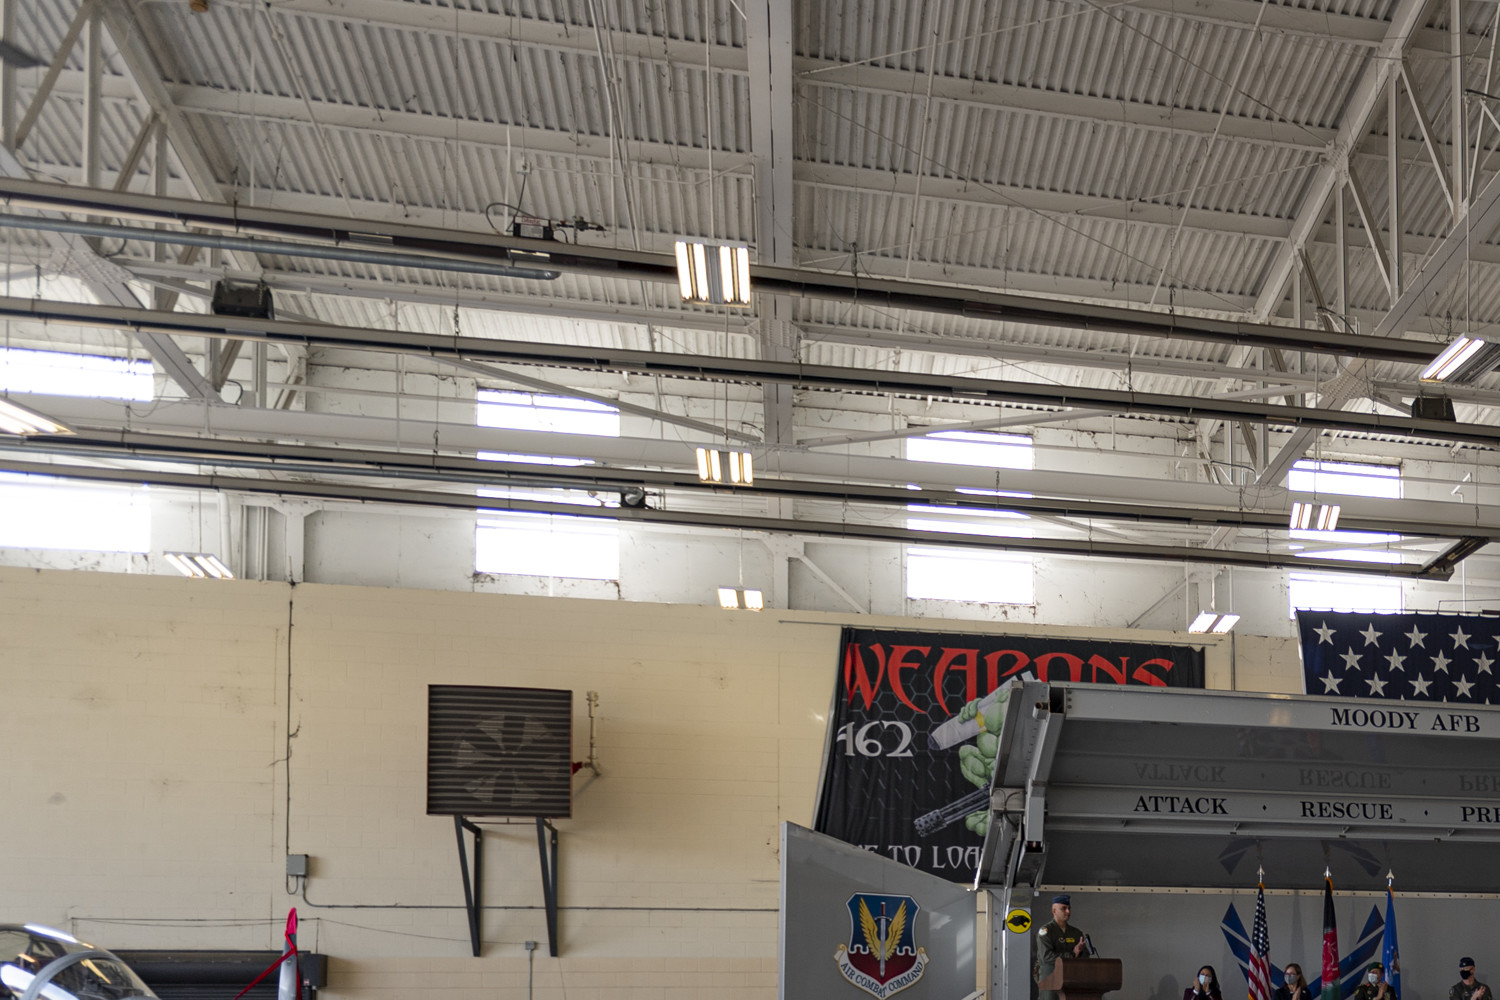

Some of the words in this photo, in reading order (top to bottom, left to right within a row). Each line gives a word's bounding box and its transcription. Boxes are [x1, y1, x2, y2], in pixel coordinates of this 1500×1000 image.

[1330, 708, 1420, 729] MOODY
[1430, 713, 1480, 733] AFB
[1133, 795, 1229, 815] ATTACK
[1300, 801, 1393, 820] RESCUE
[888, 845, 921, 868] TO
[932, 845, 983, 870] LOA
[840, 963, 856, 980] AIR
[855, 974, 888, 998] COMBAT
[888, 961, 923, 992] COMMAND
